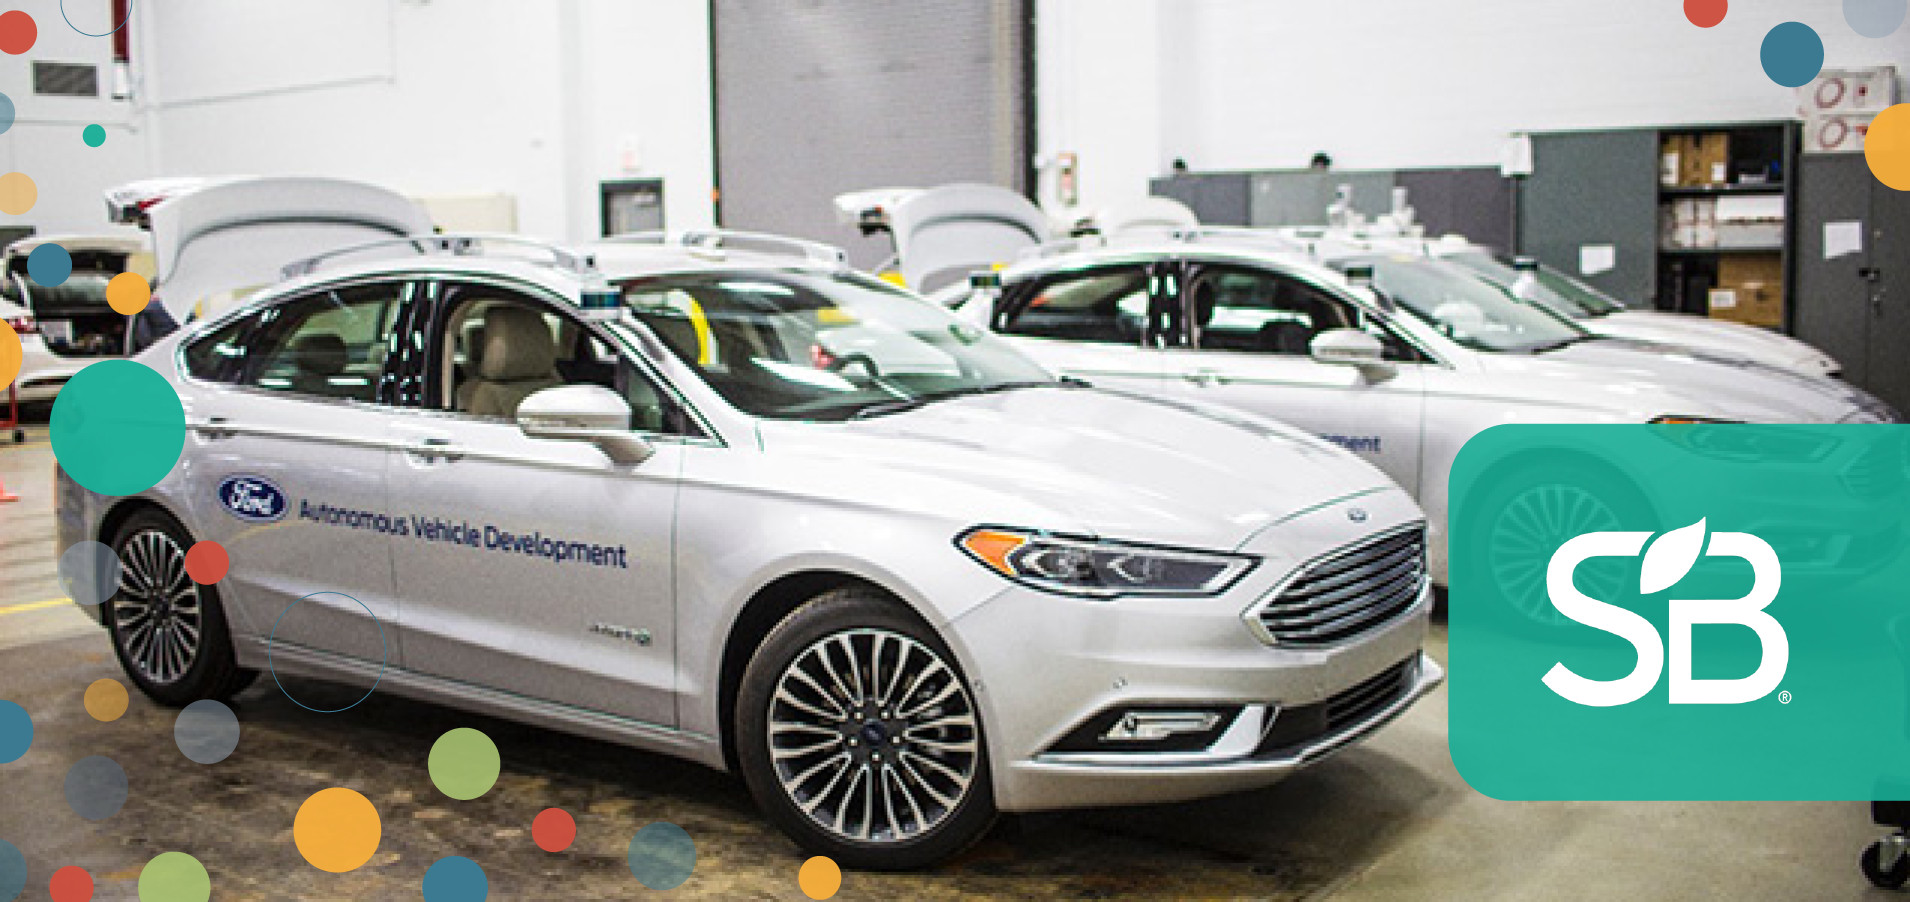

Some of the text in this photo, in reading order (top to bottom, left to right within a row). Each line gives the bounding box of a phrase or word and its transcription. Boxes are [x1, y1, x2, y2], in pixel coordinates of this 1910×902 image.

[229, 479, 276, 515] Ford
[299, 498, 628, 569] Autonomous Vehicle Development
